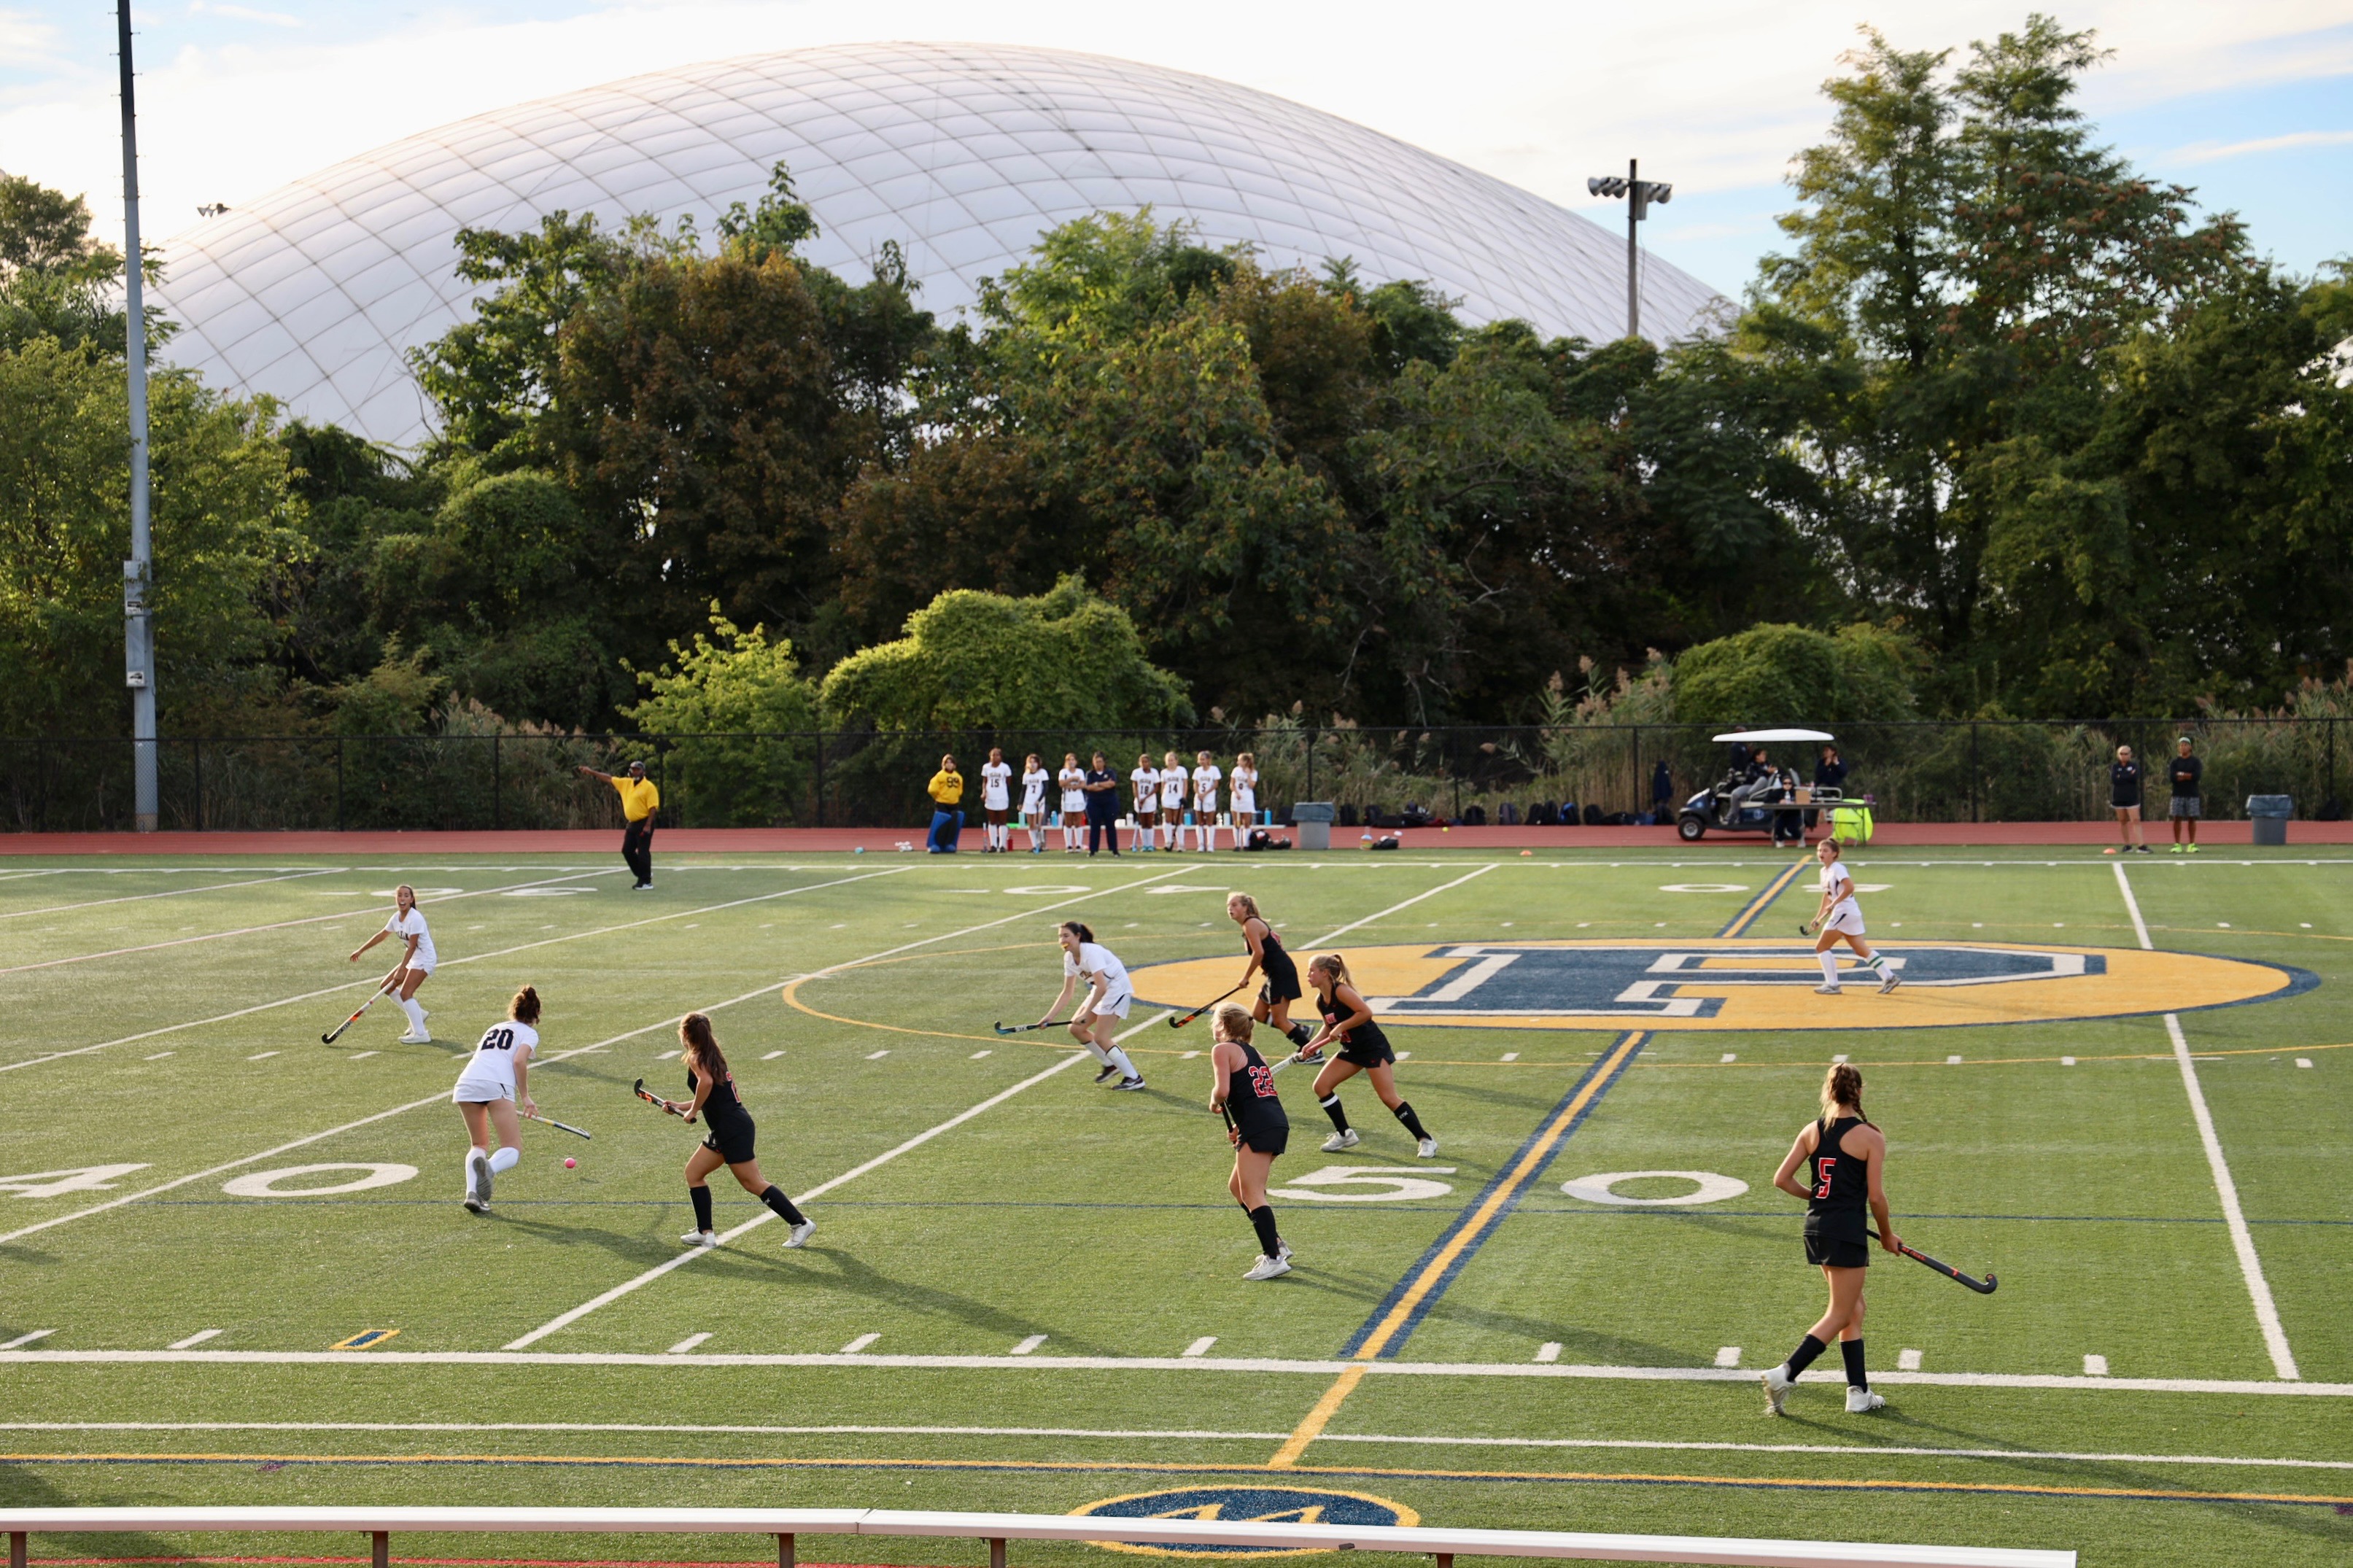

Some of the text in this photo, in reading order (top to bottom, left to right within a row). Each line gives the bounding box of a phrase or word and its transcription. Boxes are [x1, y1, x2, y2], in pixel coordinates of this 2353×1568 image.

[947, 777, 960, 788] 99
[1168, 783, 1178, 793] 14
[481, 1028, 513, 1050] 20
[1248, 1066, 1278, 1098] 22
[1815, 1157, 1837, 1200] 5
